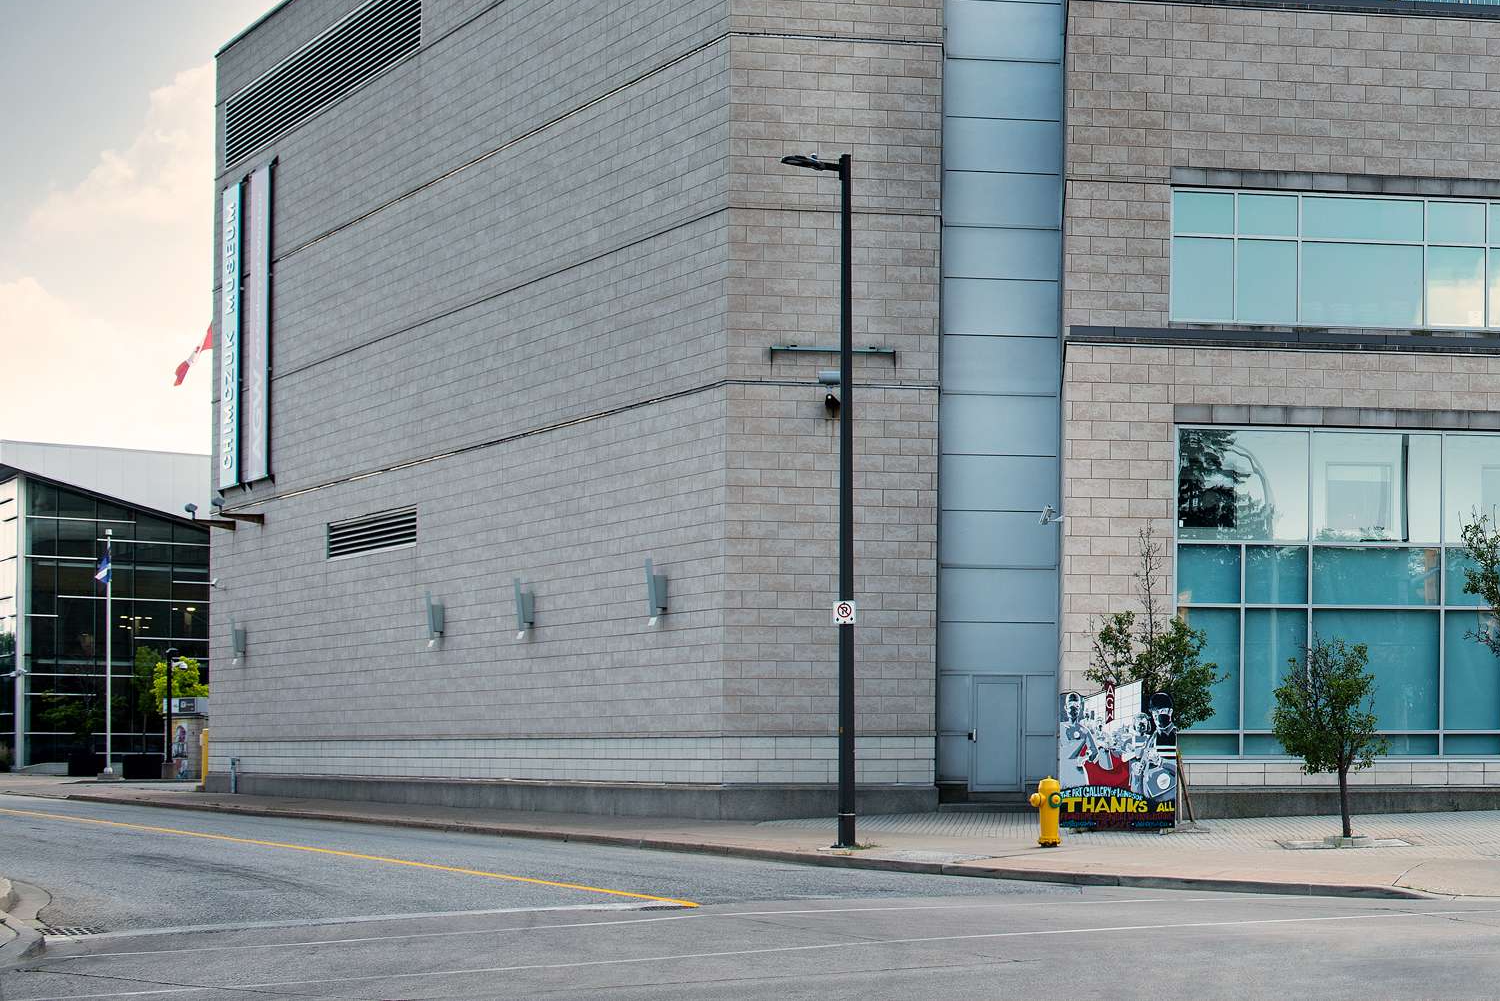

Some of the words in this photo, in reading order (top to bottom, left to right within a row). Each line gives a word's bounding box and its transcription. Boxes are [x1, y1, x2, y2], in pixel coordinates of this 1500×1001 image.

[225, 201, 236, 315] MUSEUM
[224, 330, 235, 470] CHIMCZUK
[1062, 796, 1148, 813] THANKS
[1156, 801, 1175, 812] ALL
[1083, 786, 1111, 797] GALLERY
